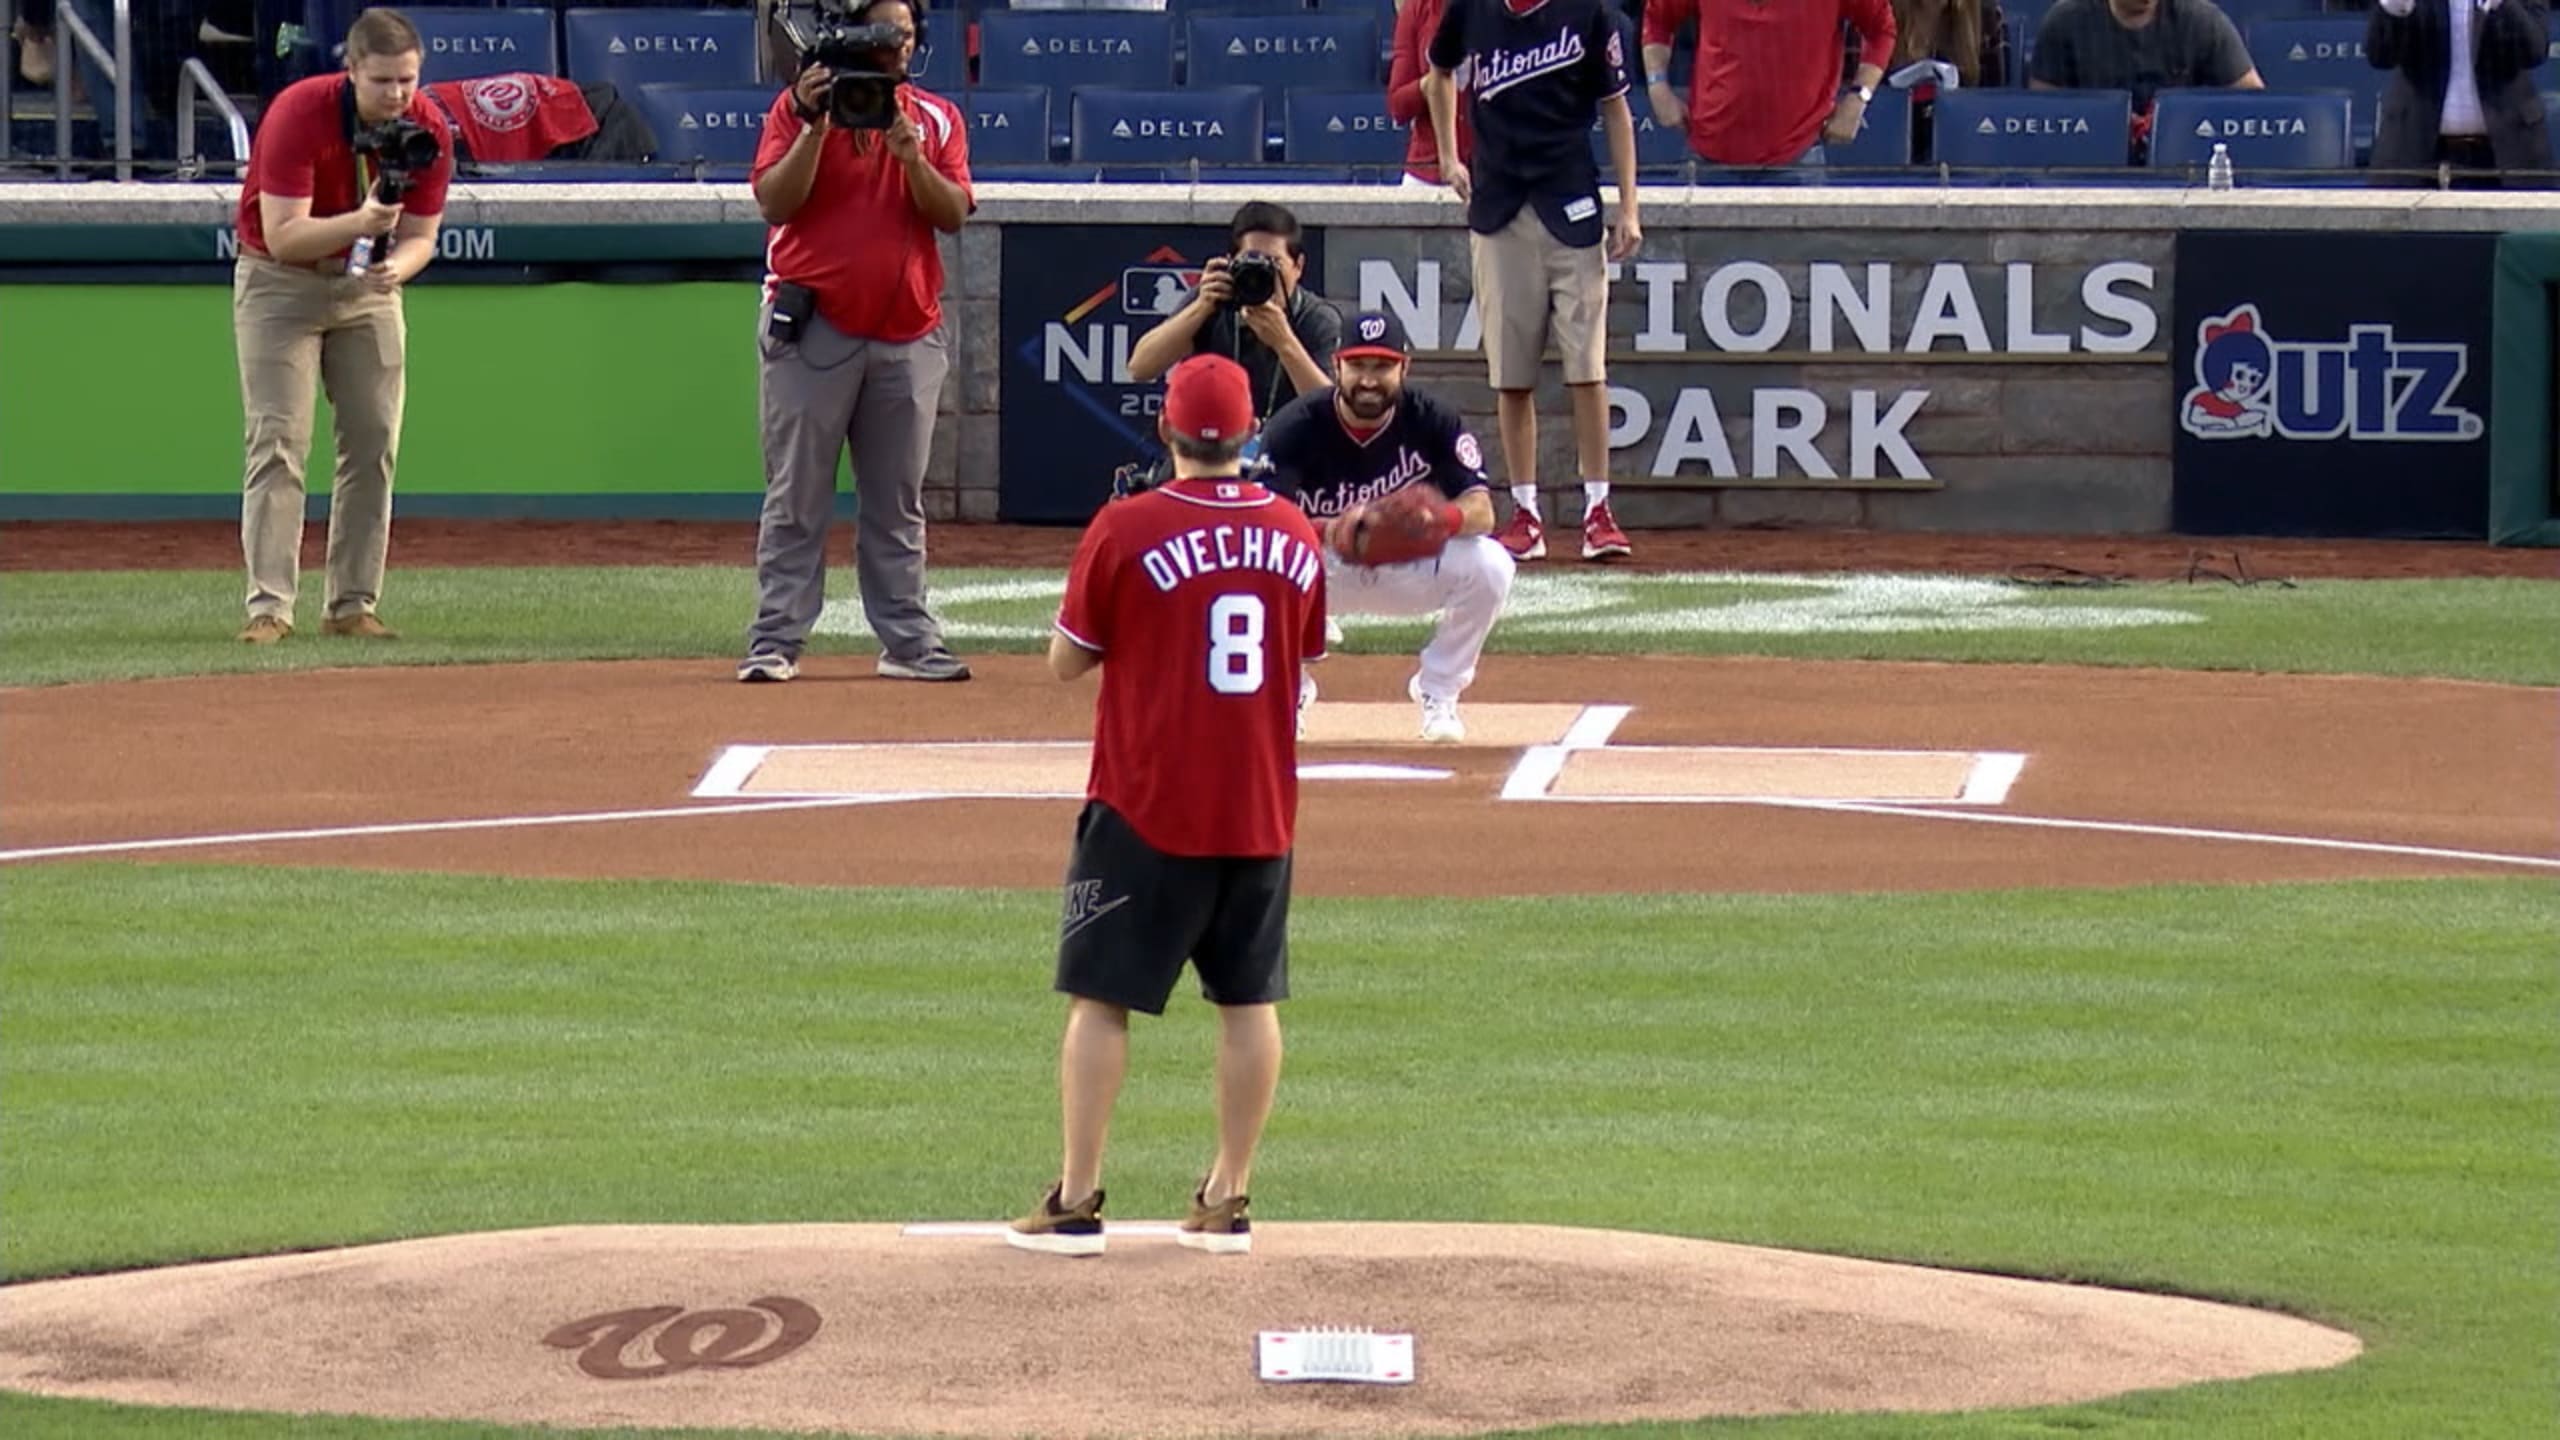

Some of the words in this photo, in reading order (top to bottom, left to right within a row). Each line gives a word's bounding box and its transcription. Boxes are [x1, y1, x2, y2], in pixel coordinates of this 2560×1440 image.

[433, 37, 516, 52] DELTA
[634, 37, 718, 52] DELTA
[1049, 38, 1132, 54] DELTA
[1255, 37, 1336, 54] DELTA
[2316, 43, 2368, 59] DEL
[706, 112, 768, 128] DELT
[1140, 120, 1223, 137] DELTA
[1353, 116, 1403, 131] DEL
[2005, 117, 2089, 134] DELTA
[2224, 118, 2305, 136] DELTA
[1360, 260, 2157, 354] NIONALS
[1120, 394, 1162, 416] 20
[1607, 388, 1932, 480] PARK
[1297, 446, 1431, 516] Nationals
[1143, 526, 1319, 592] OVECHKIN
[1209, 594, 1265, 694] 8
